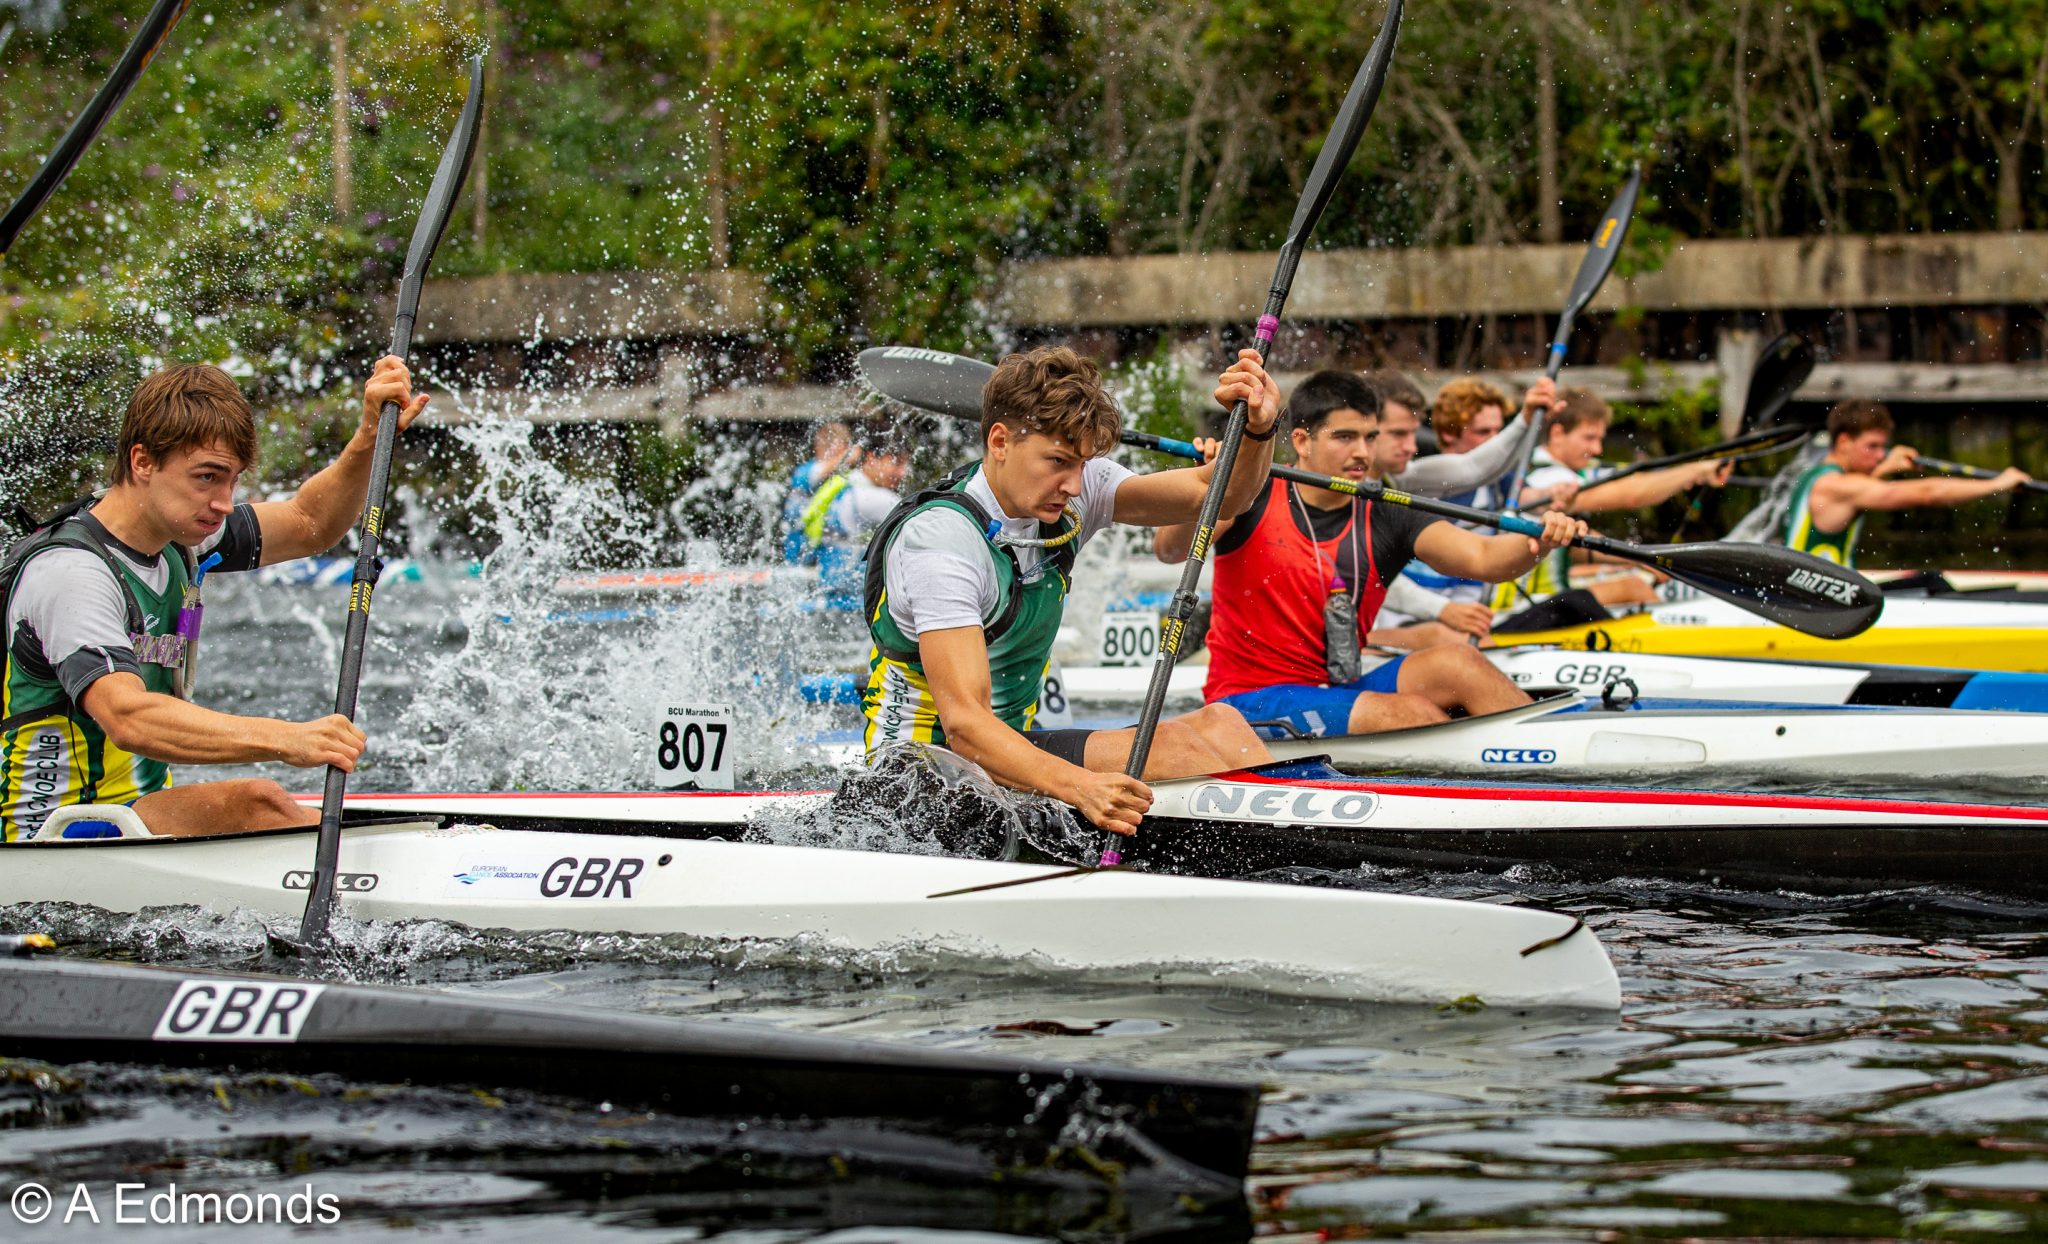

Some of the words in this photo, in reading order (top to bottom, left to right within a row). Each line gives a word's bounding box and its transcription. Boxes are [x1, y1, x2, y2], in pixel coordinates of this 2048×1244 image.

[1193, 525, 1210, 559] JANTEX
[1104, 626, 1154, 657] 800
[1167, 619, 1184, 655] JANTEX
[1555, 664, 1626, 685] GBR
[668, 707, 683, 715] BCU
[686, 708, 719, 717] Marathon
[658, 721, 727, 773] 807
[1484, 750, 1554, 762] NELO
[1196, 786, 1374, 820] NELO
[286, 872, 376, 890] NLO
[540, 857, 645, 898] GBR
[169, 986, 307, 1035] GBR
